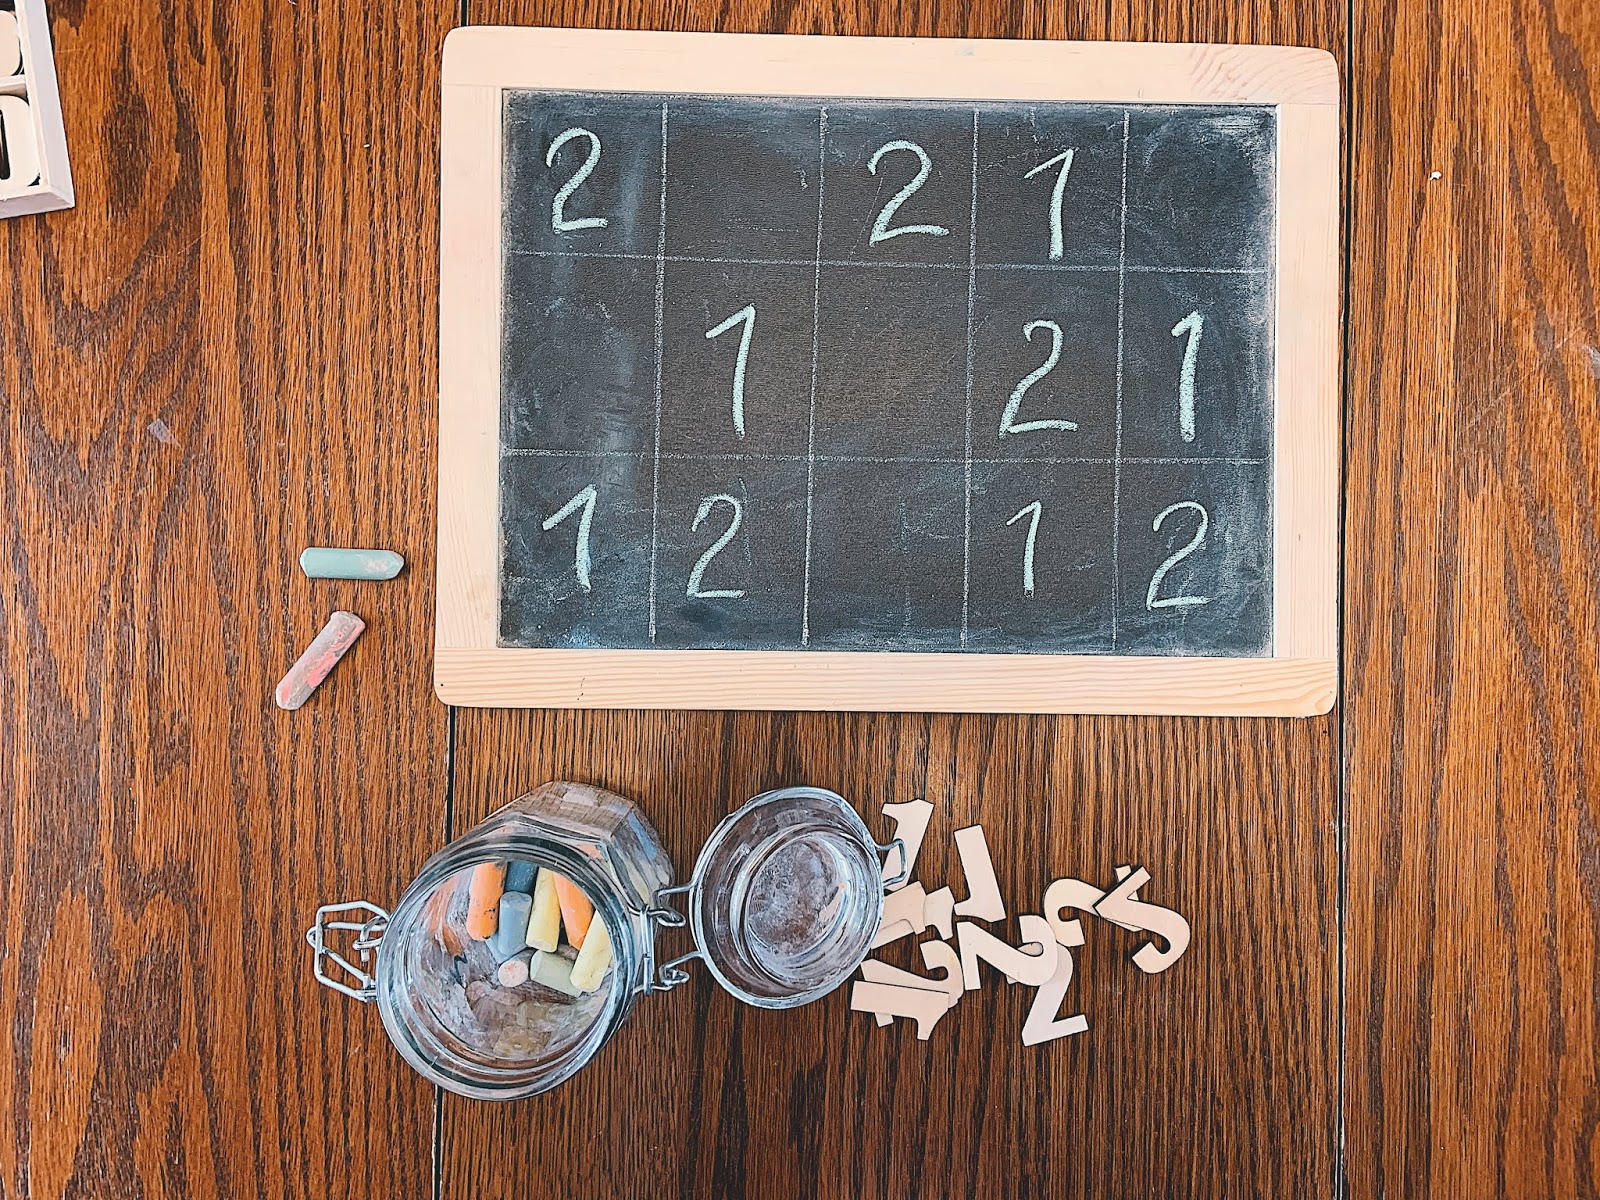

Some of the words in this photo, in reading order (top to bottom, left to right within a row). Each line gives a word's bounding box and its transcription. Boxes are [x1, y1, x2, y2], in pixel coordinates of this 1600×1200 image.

[546, 127, 608, 234] 2
[867, 139, 949, 247] 2
[1024, 148, 1075, 261] 1
[705, 303, 756, 439] 1
[999, 319, 1078, 438] 2
[1171, 311, 1204, 442] 1
[542, 484, 597, 592] 1
[686, 493, 746, 599] 2
[1006, 501, 1042, 597] 1
[1147, 501, 1212, 610] 2
[881, 798, 935, 892] 1
